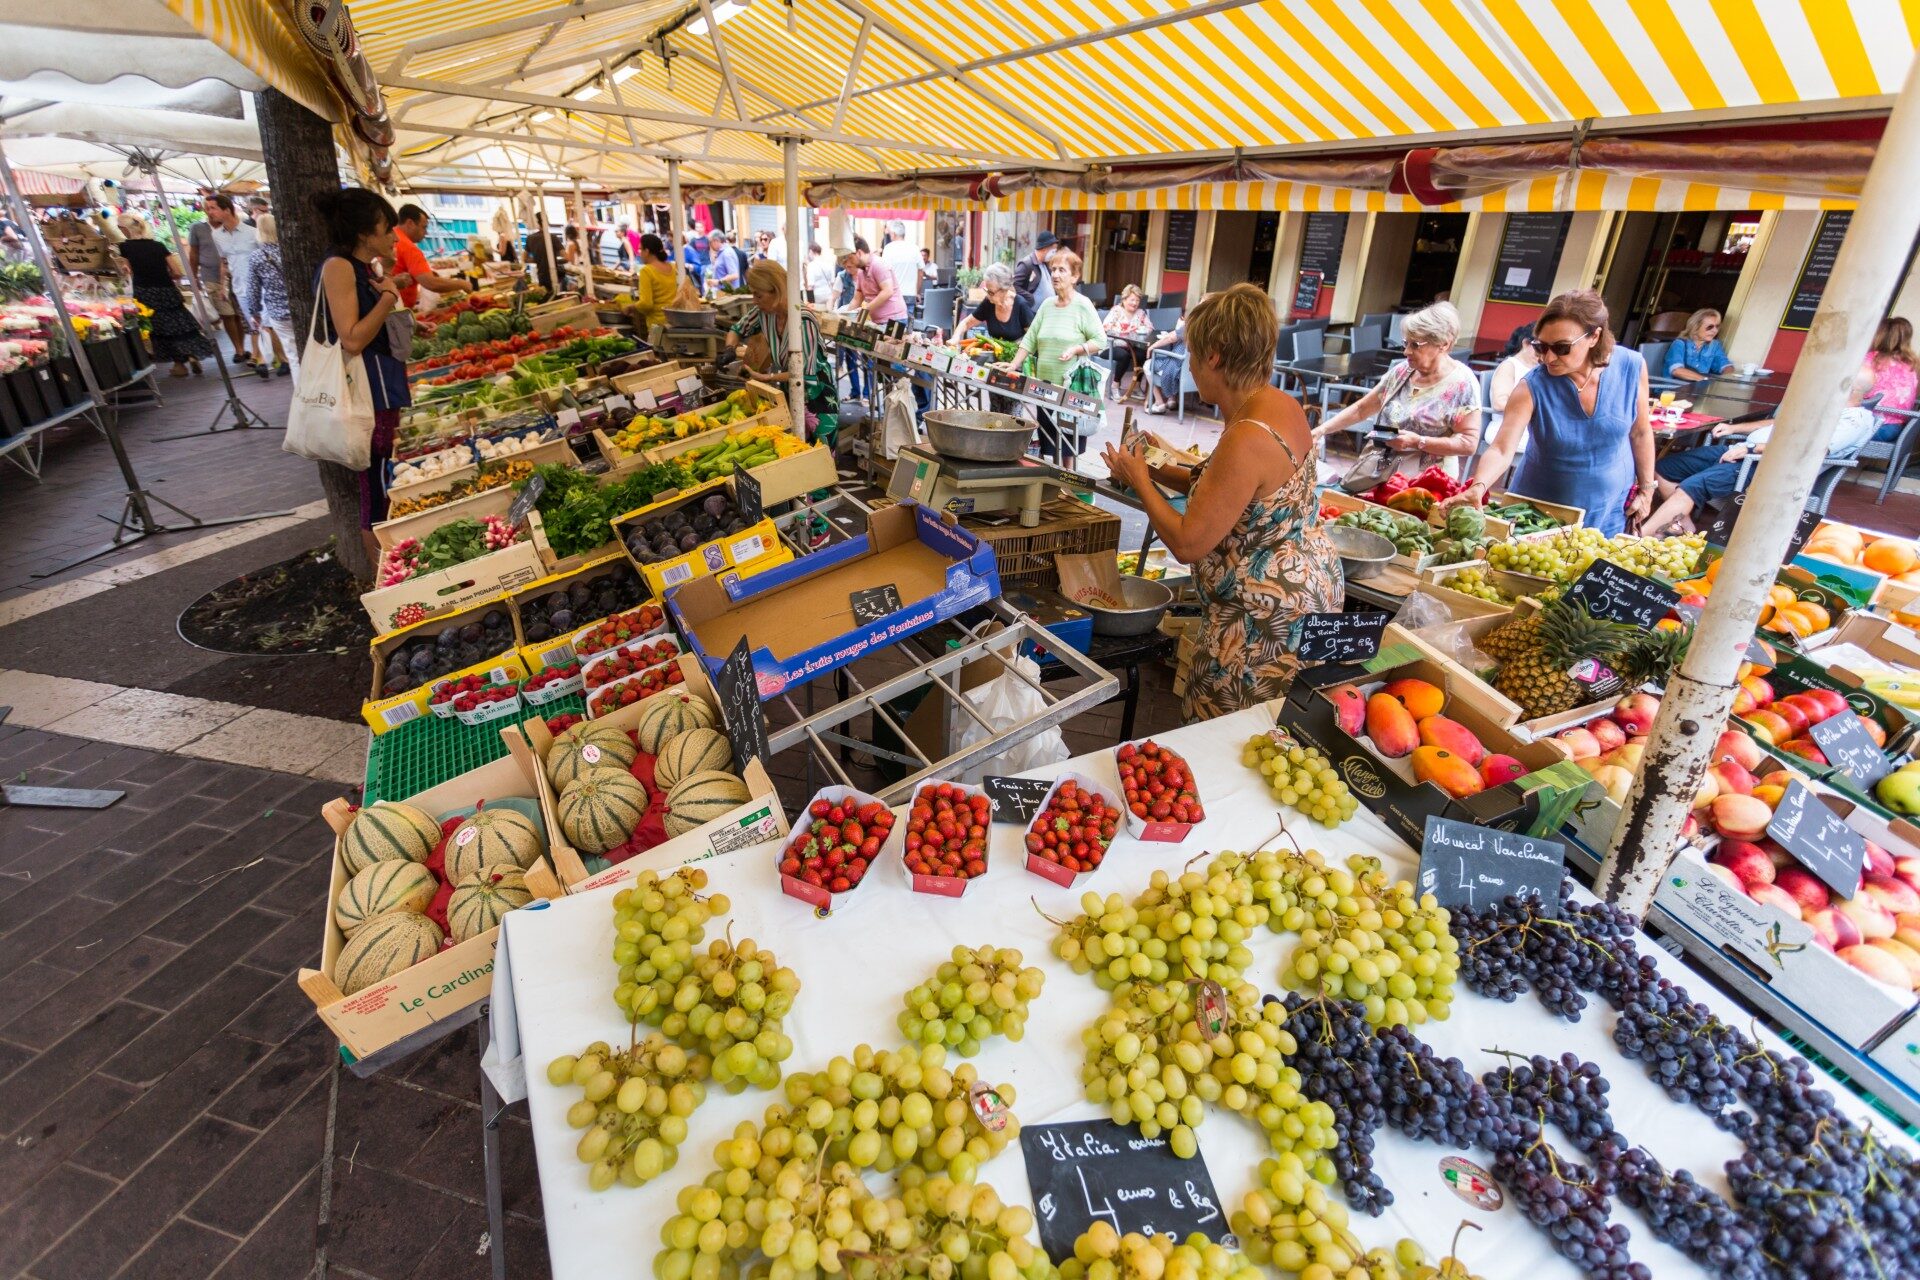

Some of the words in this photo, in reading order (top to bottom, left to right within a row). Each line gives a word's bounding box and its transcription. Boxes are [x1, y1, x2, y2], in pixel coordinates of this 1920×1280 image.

[460, 592, 474, 603] Jean
[473, 584, 502, 598] PIGNARD
[784, 666, 804, 684] Les
[803, 654, 833, 674] fruits
[833, 639, 868, 658] rouges
[869, 629, 887, 646] des
[887, 610, 935, 638] Fontaines
[1788, 670, 1800, 682] La
[1818, 678, 1835, 691] Verger
[554, 679, 583, 694] JOLIBOIS
[485, 702, 515, 715] JOLIBOIS
[1361, 779, 1384, 798] cielo
[1389, 804, 1403, 818] Costa
[1402, 815, 1420, 834] Tropical
[718, 826, 736, 838] FRANCE
[1432, 824, 1485, 851] Muscat
[1458, 856, 1477, 906] 4
[1478, 873, 1505, 886] euros
[1694, 877, 1718, 895] Le
[1718, 905, 1732, 917] des
[359, 985, 391, 1001] CARDINAL
[400, 997, 424, 1014] Le
[1075, 1165, 1122, 1237] 4
[1117, 1186, 1156, 1202] euros
[1168, 1187, 1185, 1209] le
[1185, 1180, 1220, 1224] kg
